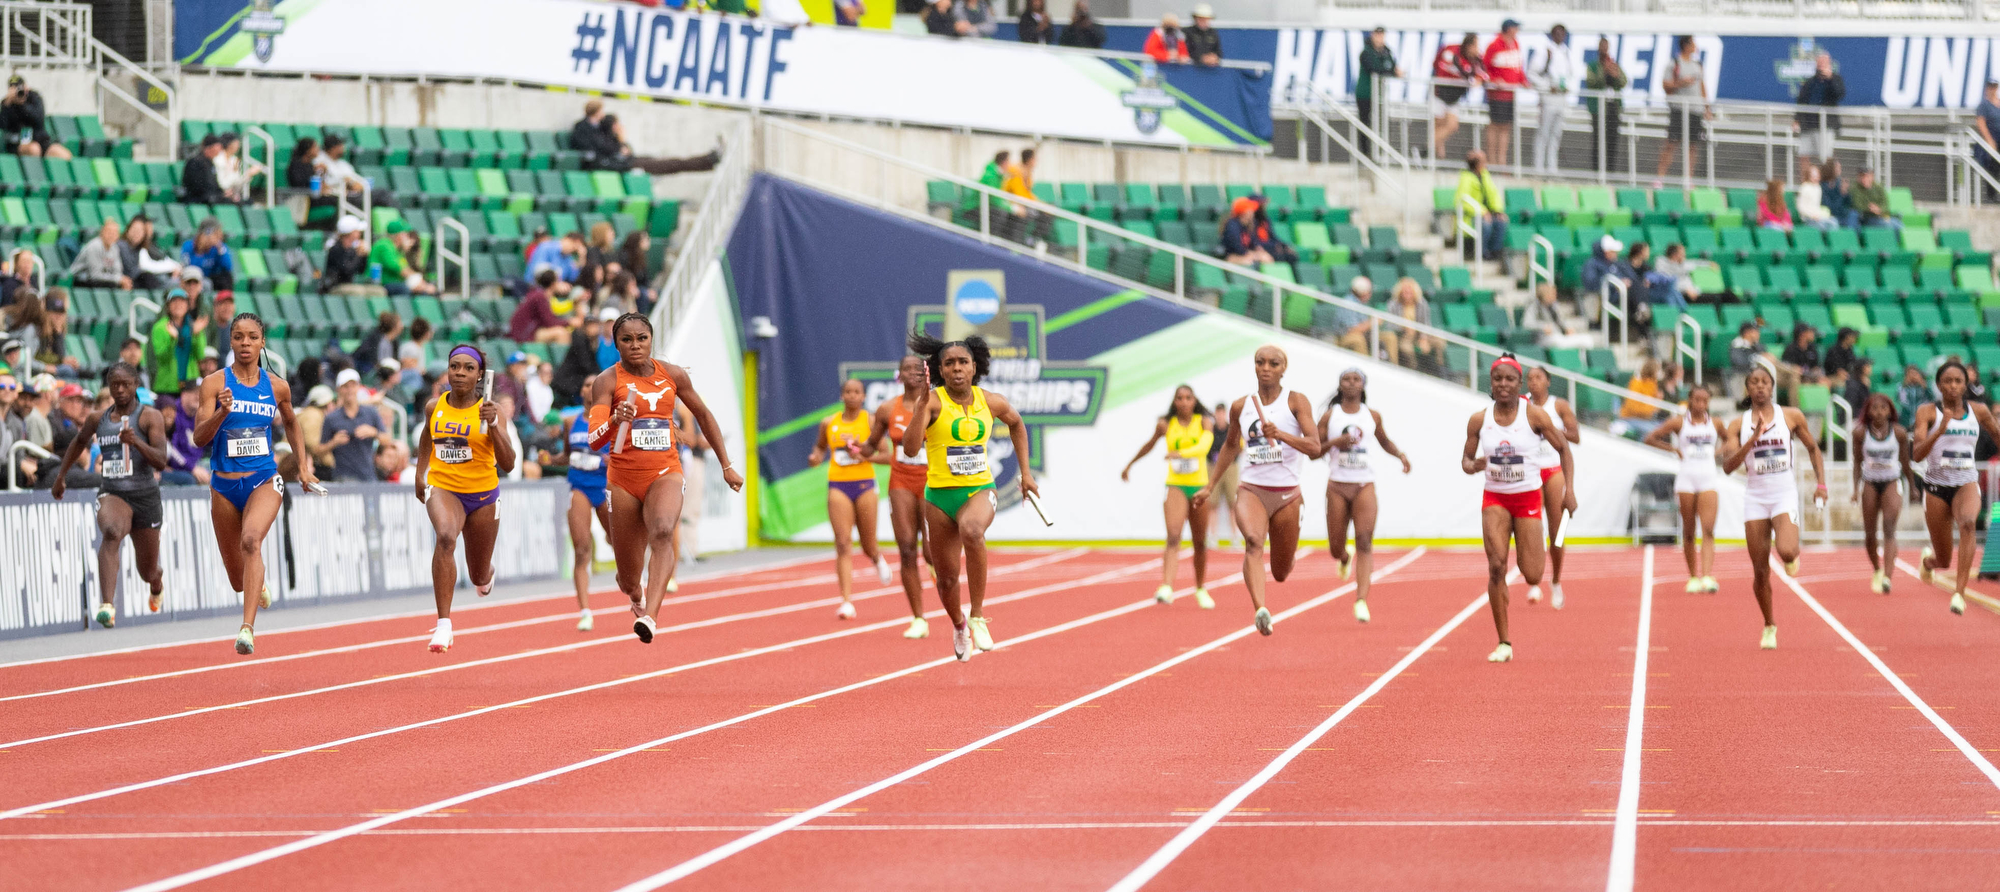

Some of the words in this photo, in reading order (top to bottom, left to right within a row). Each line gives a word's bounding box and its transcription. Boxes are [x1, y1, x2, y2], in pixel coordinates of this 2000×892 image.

[570, 9, 793, 101] #NCAATF
[1880, 36, 2000, 108] UNI
[230, 399, 276, 418] ENTUCKY
[434, 421, 471, 437] LSU
[951, 416, 985, 442] O
[634, 436, 670, 446] FLANNEL
[236, 445, 261, 455] DAVIS
[440, 449, 468, 459] DAVIES
